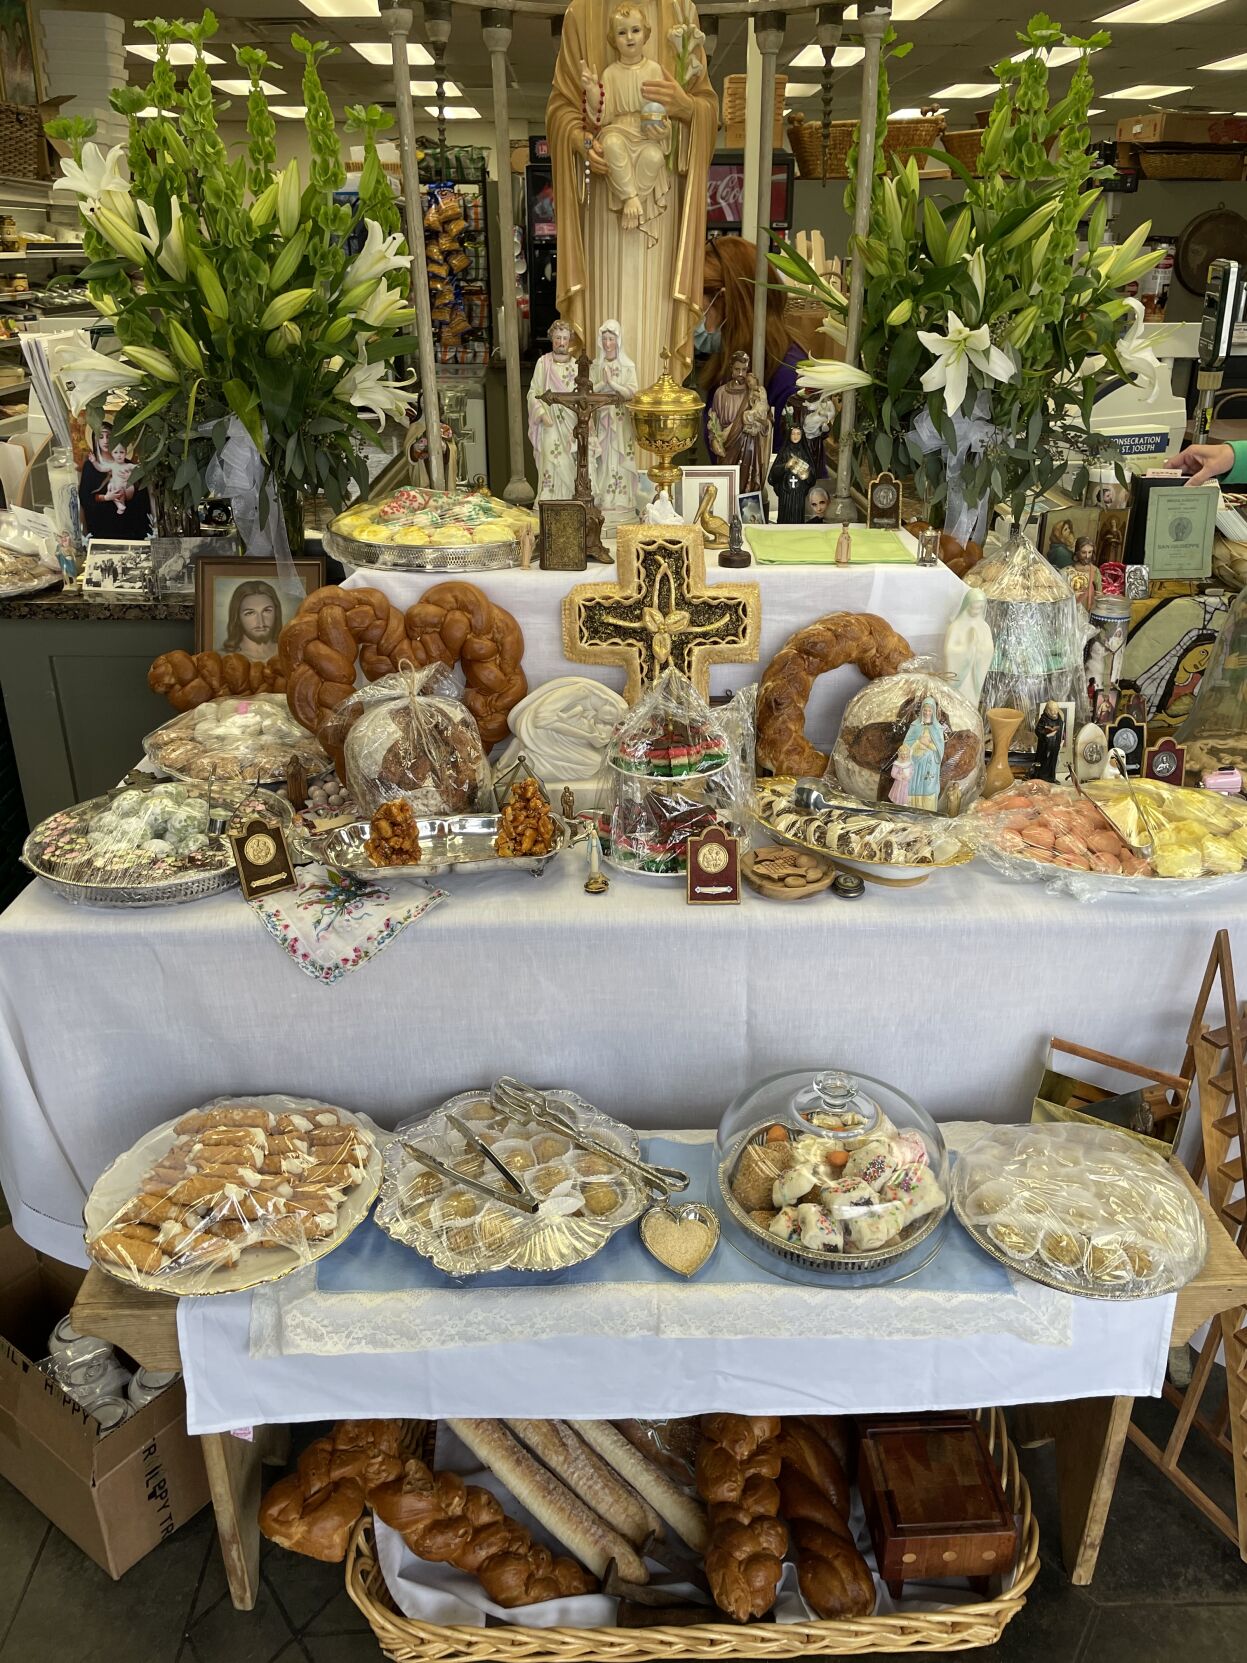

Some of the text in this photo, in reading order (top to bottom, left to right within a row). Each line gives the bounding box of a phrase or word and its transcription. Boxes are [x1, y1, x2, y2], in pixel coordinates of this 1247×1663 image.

[1111, 436, 1160, 445] ONSECRATION
[1121, 444, 1155, 454] ST. JOSEPH
